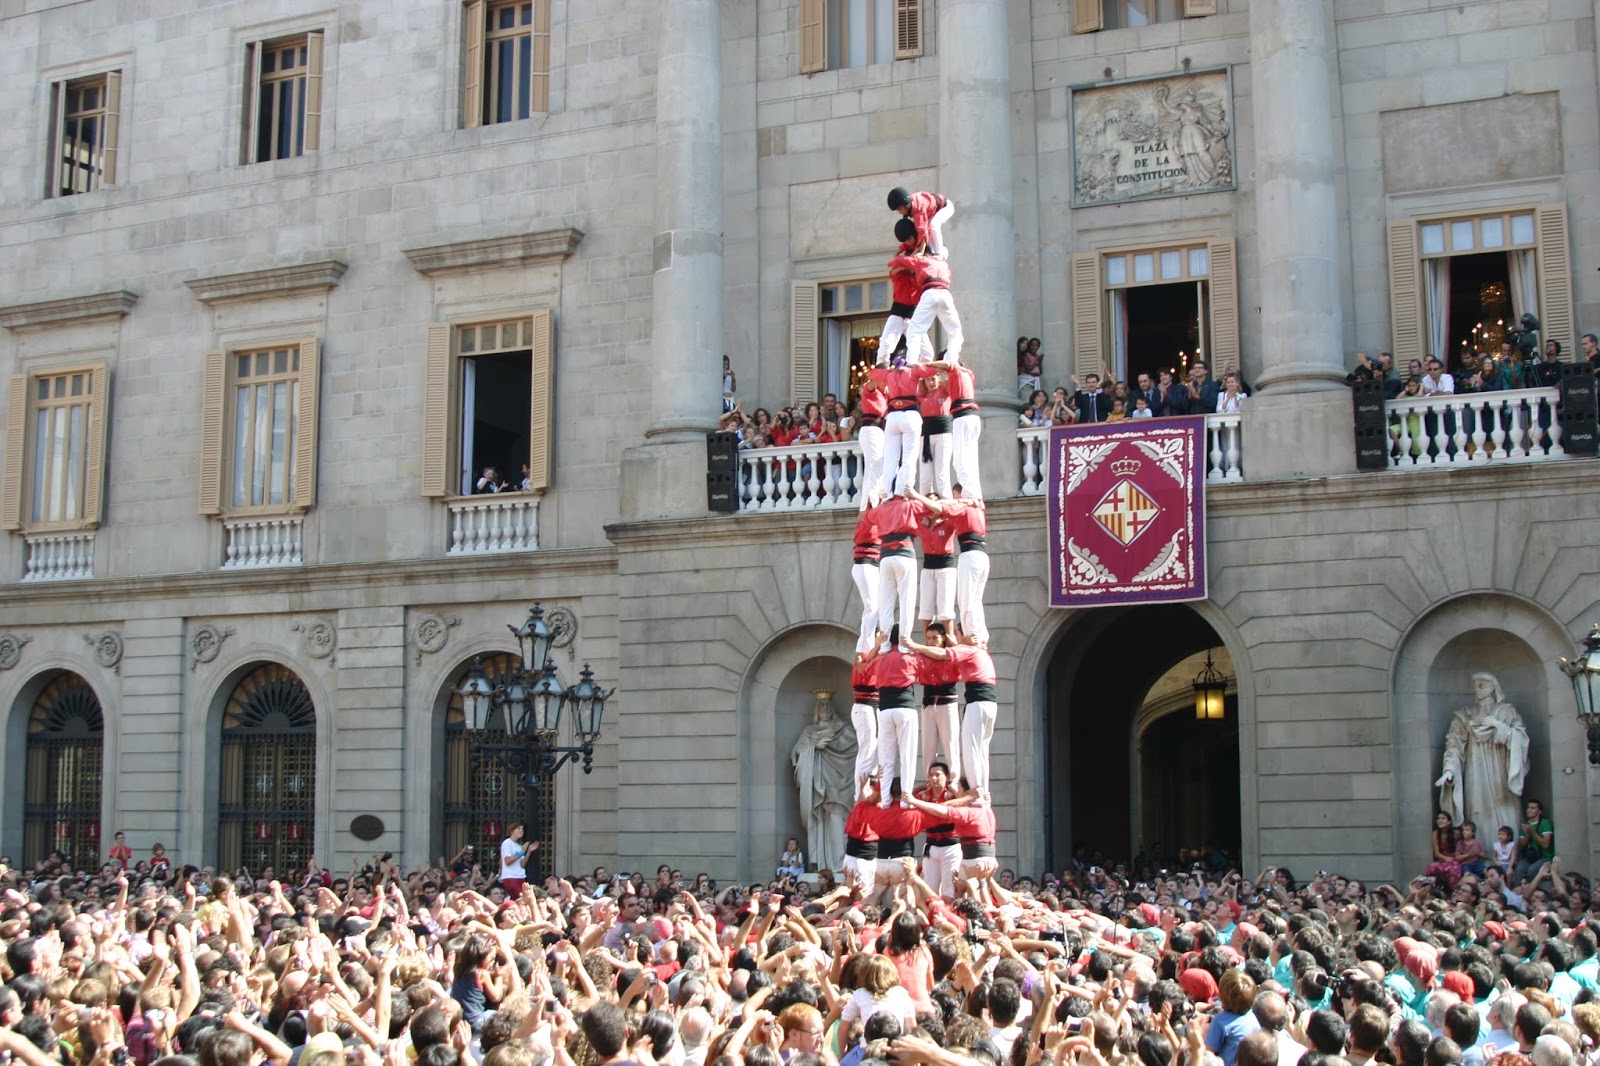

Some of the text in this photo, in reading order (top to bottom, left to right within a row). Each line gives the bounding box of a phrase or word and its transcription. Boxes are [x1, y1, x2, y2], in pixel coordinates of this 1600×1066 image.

[1134, 143, 1169, 154] PLAZA
[1134, 156, 1170, 168] DE LA
[1116, 166, 1189, 184] CONSTITUCION
